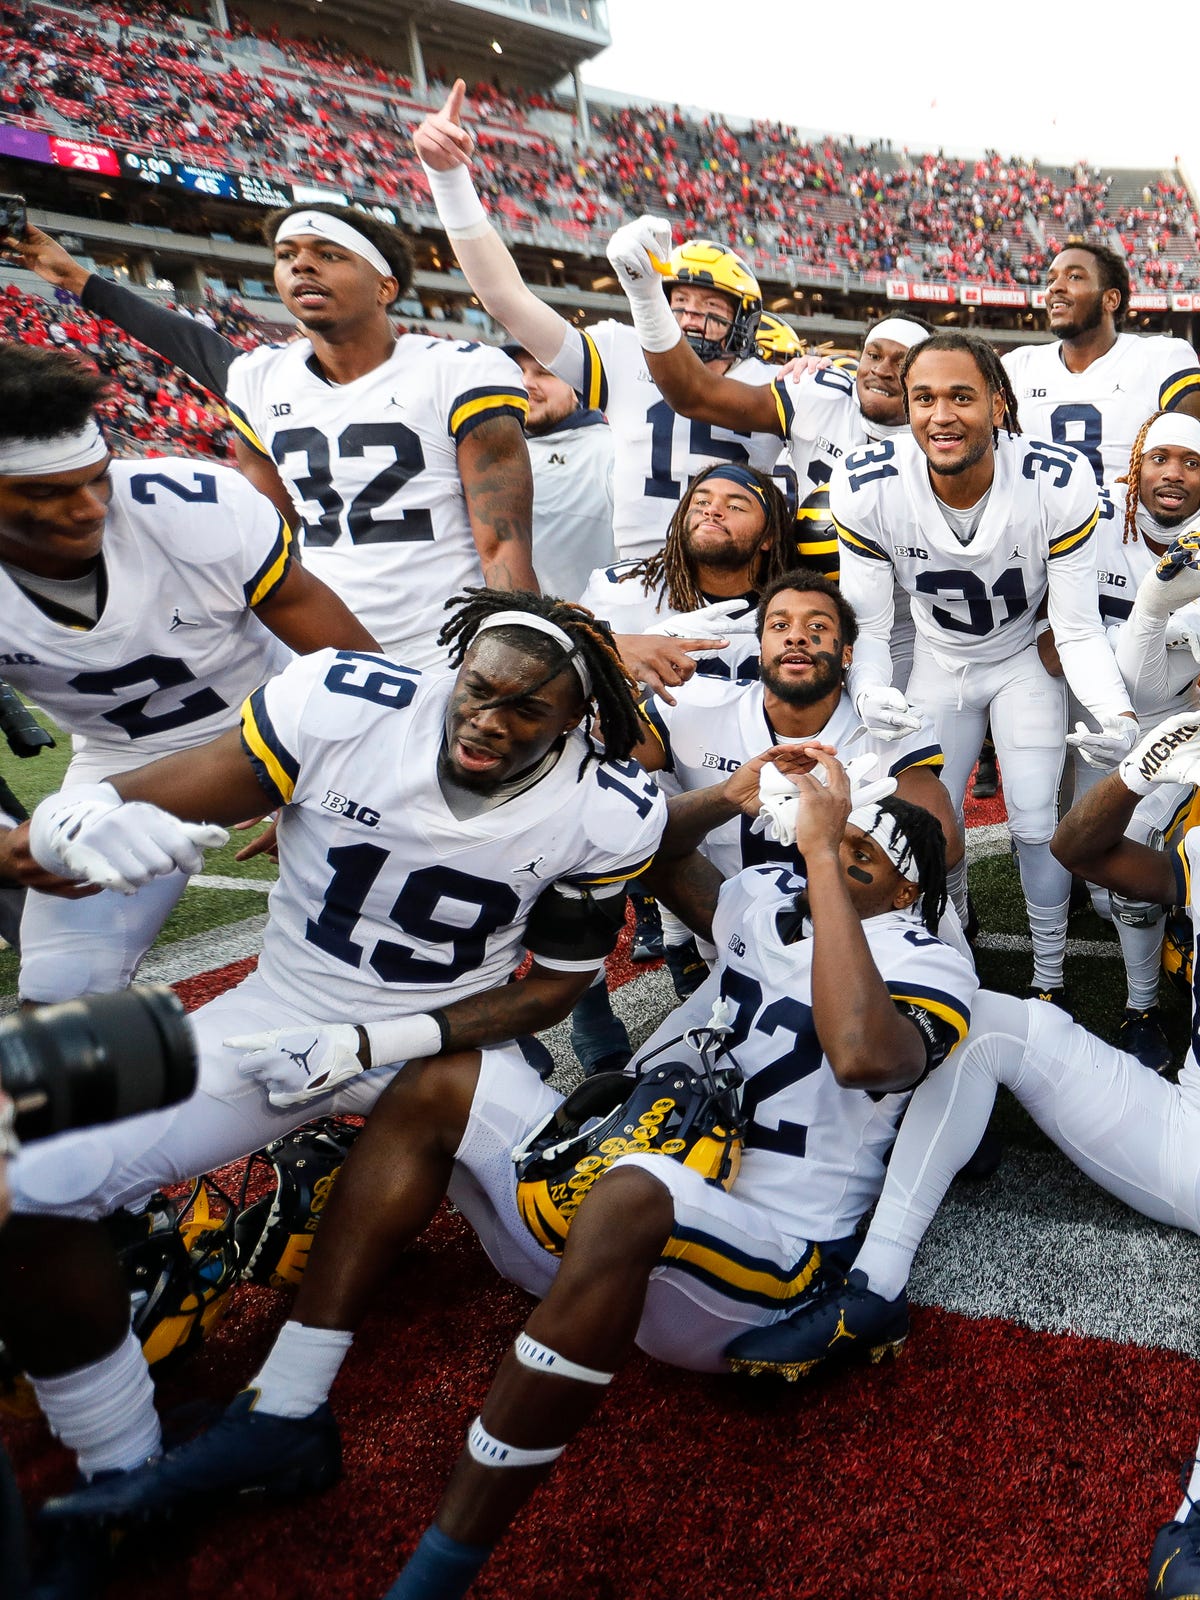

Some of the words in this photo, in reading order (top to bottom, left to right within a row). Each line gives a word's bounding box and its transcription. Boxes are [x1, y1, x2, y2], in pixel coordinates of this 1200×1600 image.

[72, 152, 100, 170] 23
[125, 153, 172, 175] 0:00
[194, 176, 221, 195] 45
[913, 285, 949, 301] SMITH
[131, 471, 218, 505] 2
[271, 422, 435, 547] 32
[845, 439, 899, 493] 31
[1022, 440, 1078, 489] 31
[915, 567, 1028, 637] 31
[67, 654, 230, 740] 2
[307, 842, 520, 984] 19
[719, 965, 828, 1158] 22
[551, 1183, 567, 1201] 22
